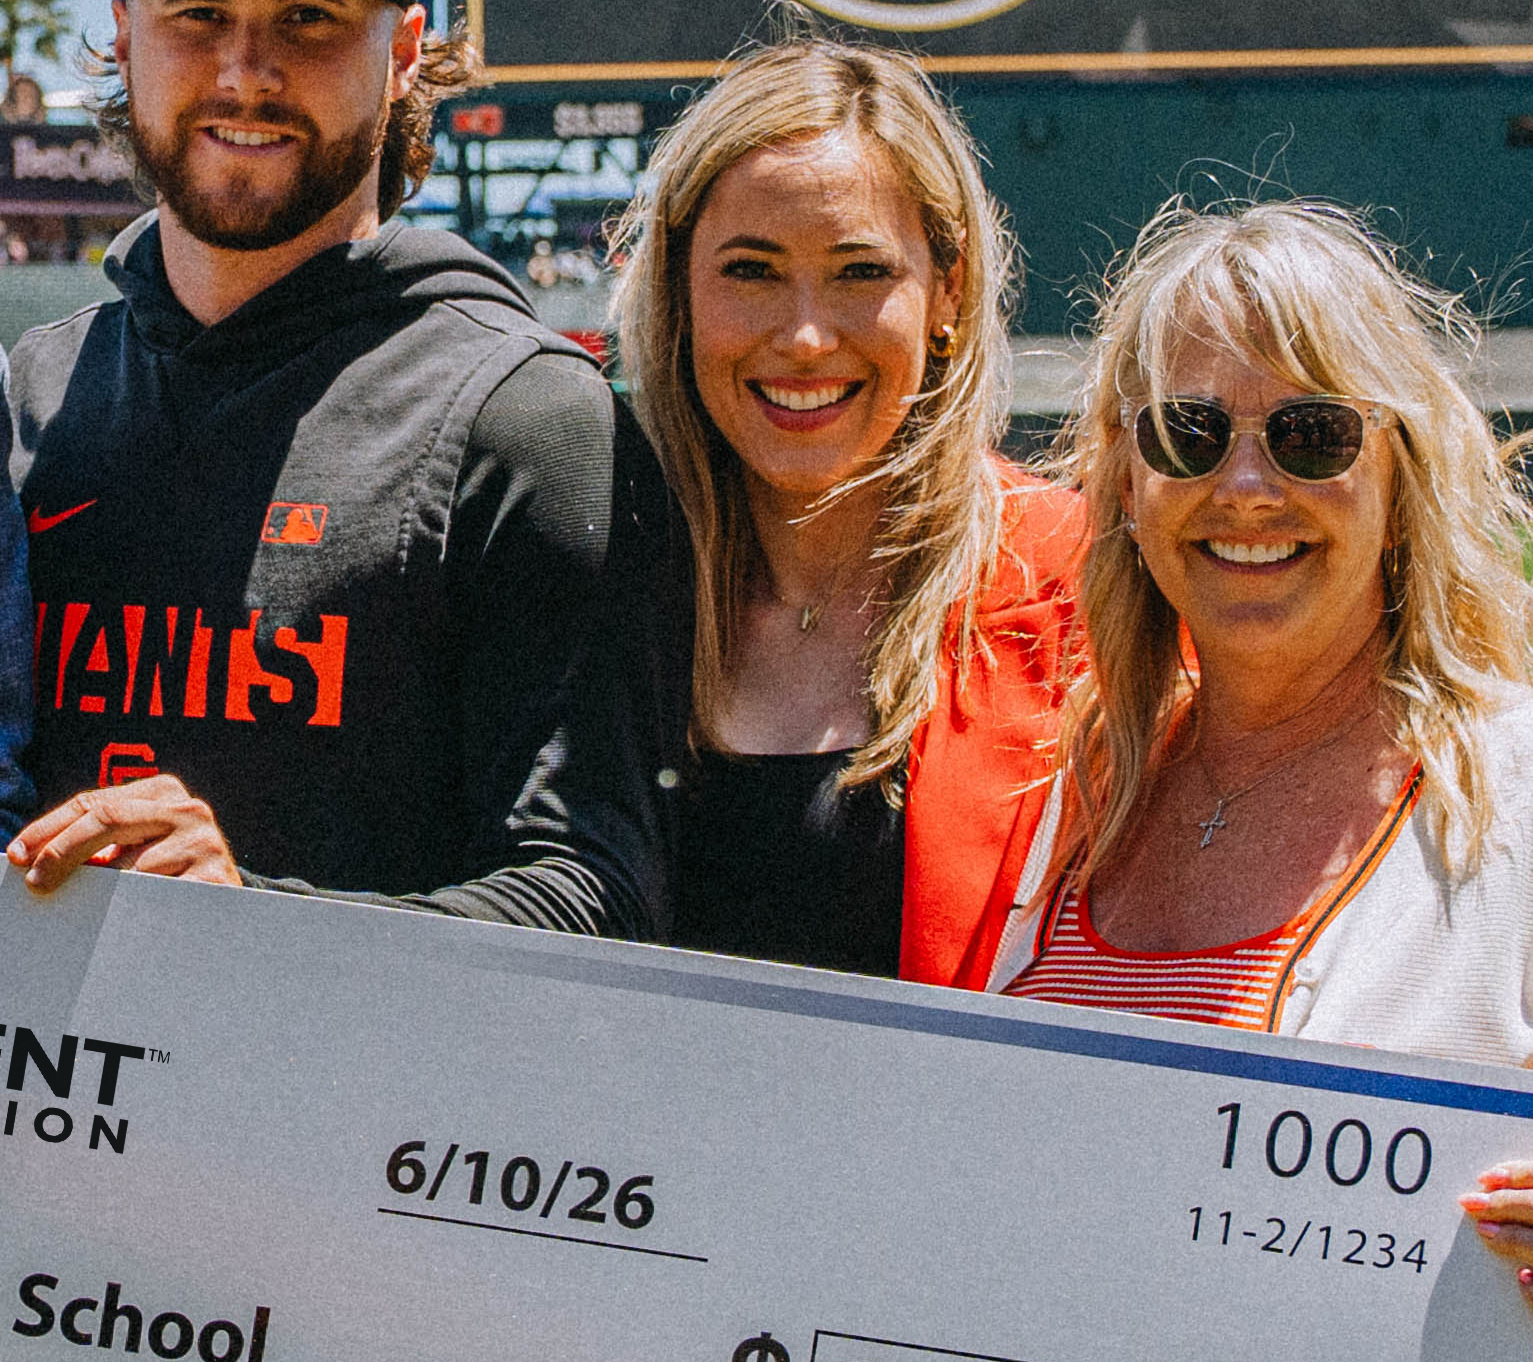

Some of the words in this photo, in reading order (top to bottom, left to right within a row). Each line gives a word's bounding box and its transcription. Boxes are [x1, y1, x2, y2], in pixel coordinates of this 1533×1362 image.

[33, 602, 349, 727] IANTS
[385, 1139, 656, 1230] 6/10/26
[1215, 1101, 1434, 1198] 1000
[1187, 1205, 1430, 1275] 11-2/1234
